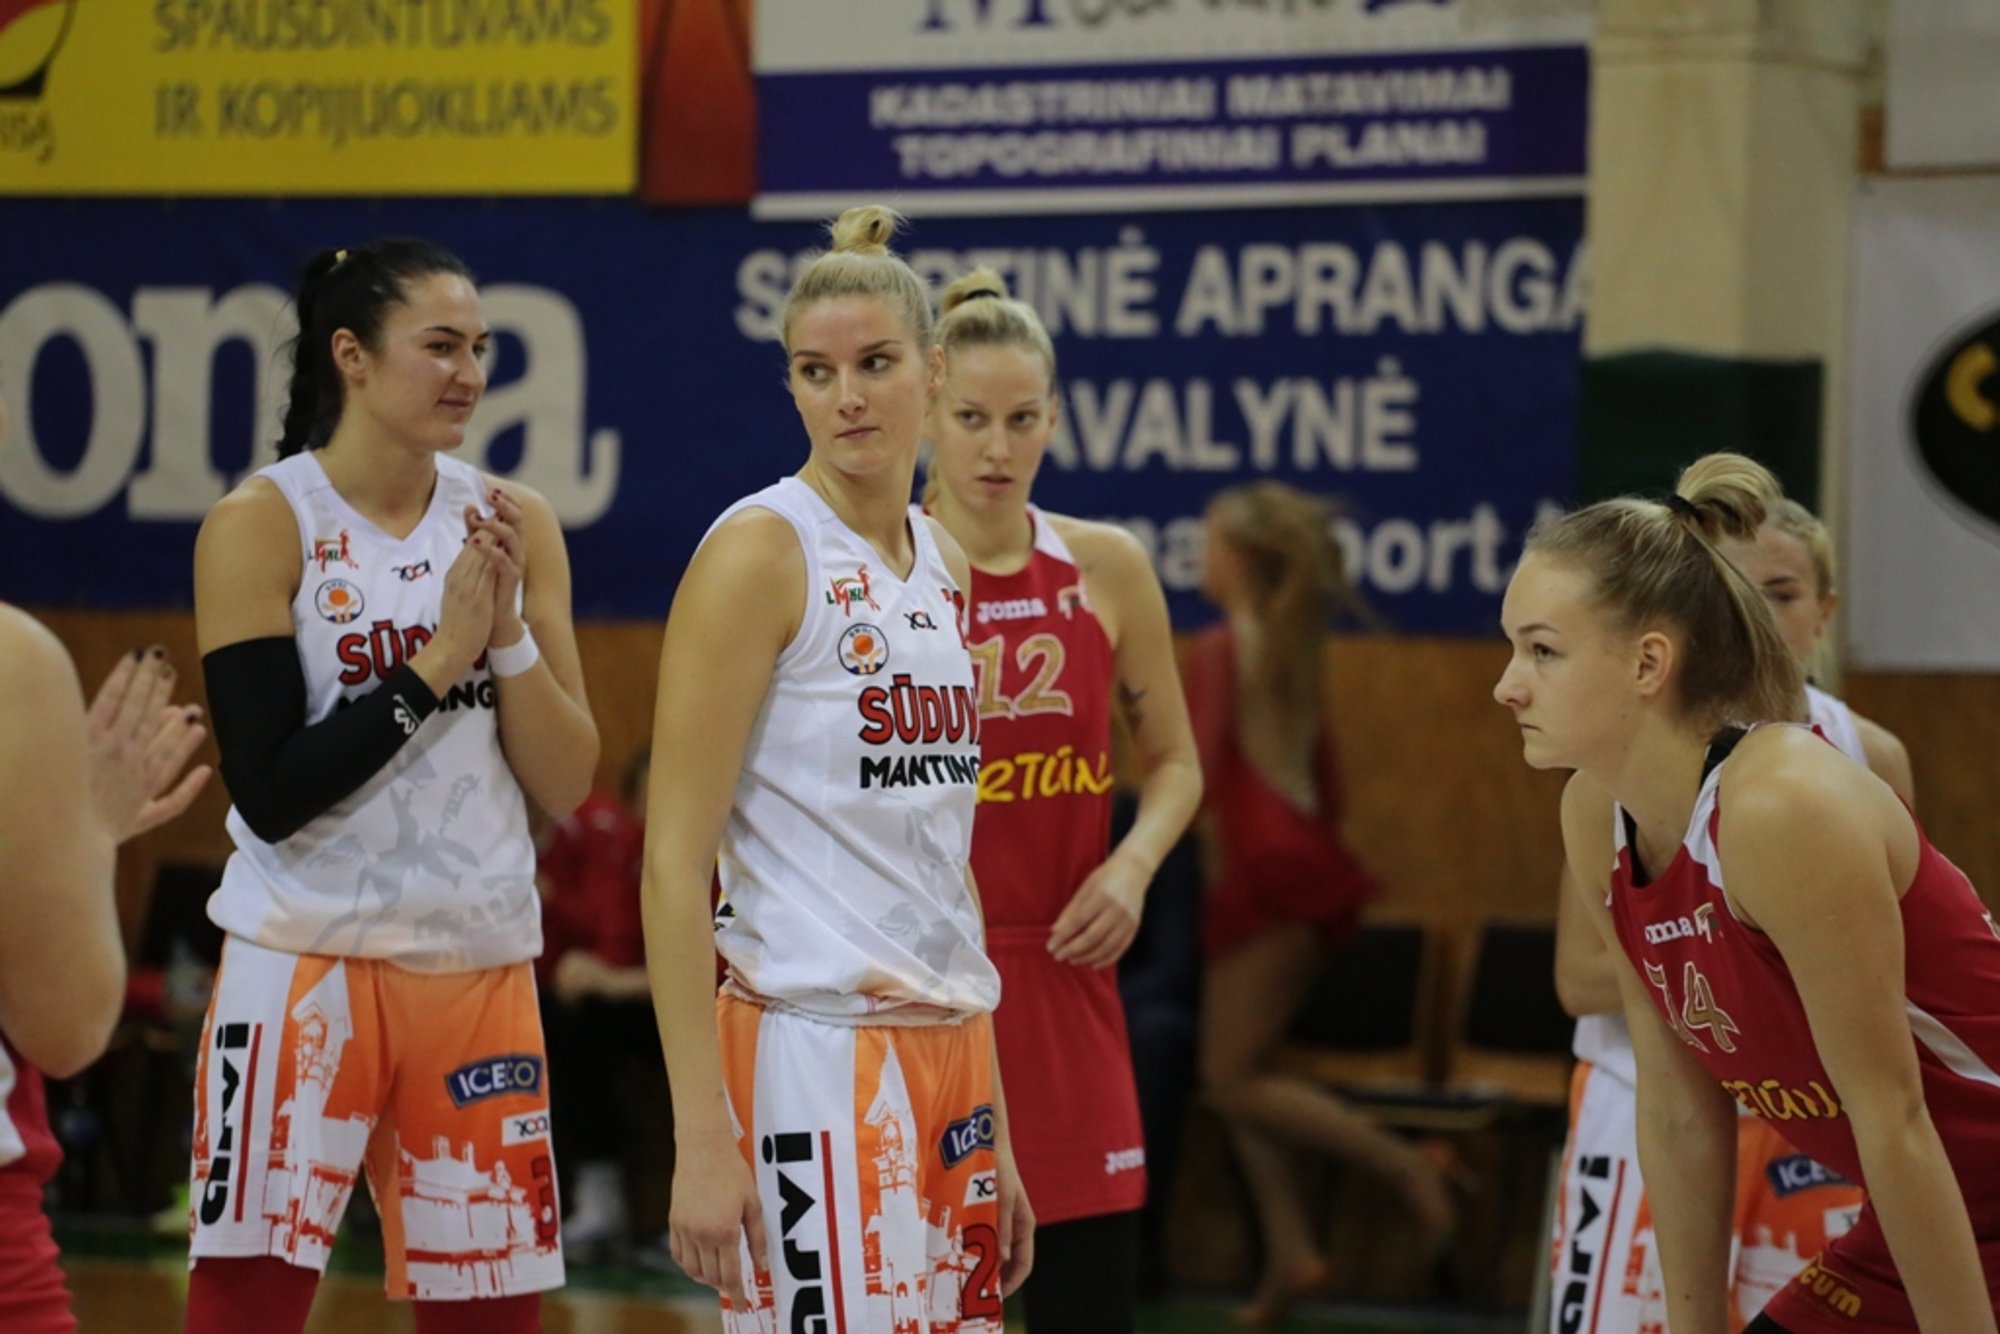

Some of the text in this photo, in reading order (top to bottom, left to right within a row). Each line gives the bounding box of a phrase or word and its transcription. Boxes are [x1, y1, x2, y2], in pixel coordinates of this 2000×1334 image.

[154, 83, 200, 138] IR
[1226, 68, 1512, 118] MATAVIMAI
[1291, 119, 1488, 168] PLANAI
[967, 632, 1074, 720] 12
[857, 673, 979, 746] SŪDUV
[1642, 957, 1741, 1054] 14
